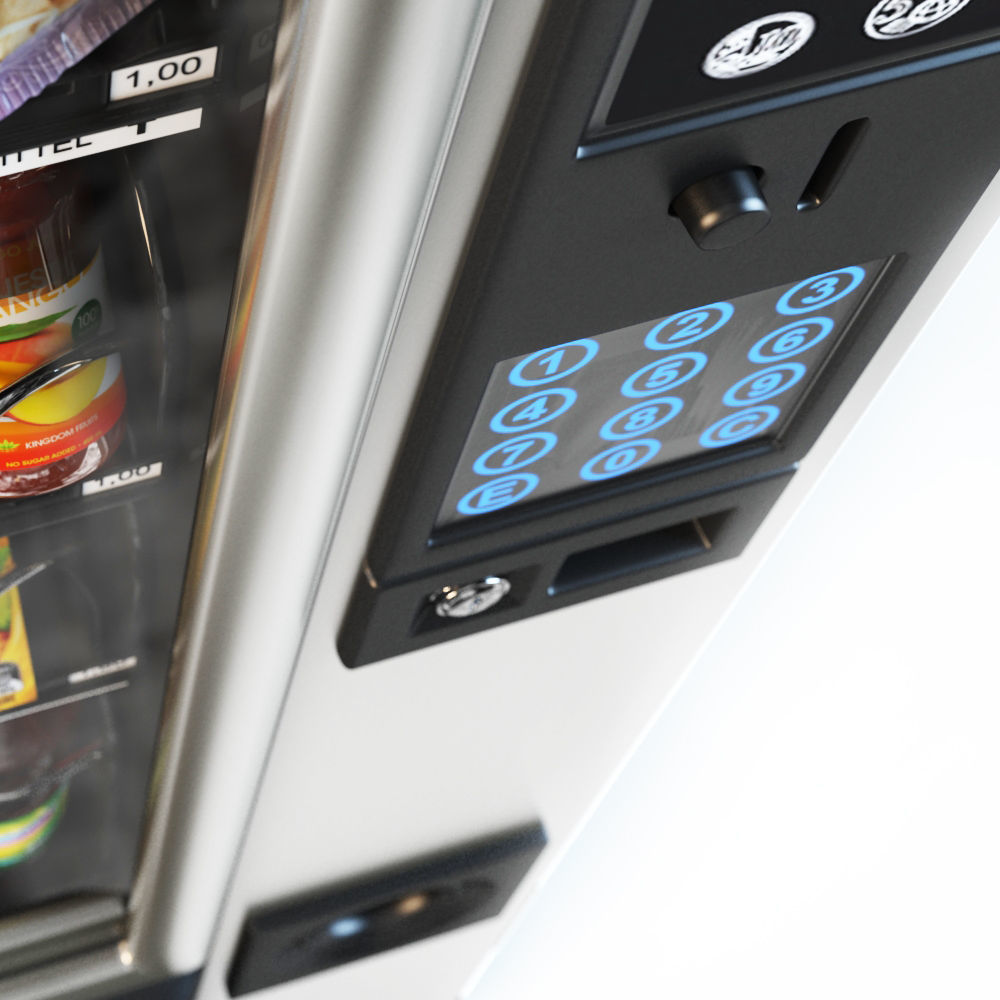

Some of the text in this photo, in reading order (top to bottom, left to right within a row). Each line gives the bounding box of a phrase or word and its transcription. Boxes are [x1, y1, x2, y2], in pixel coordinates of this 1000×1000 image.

[125, 55, 203, 90] 1,00
[540, 276, 839, 375] 1 2 3
[502, 373, 779, 467] 7 8 9
[511, 327, 806, 422] 4 5 6
[25, 427, 76, 450] KINGDOM
[476, 480, 517, 508] E
[721, 414, 760, 438] C
